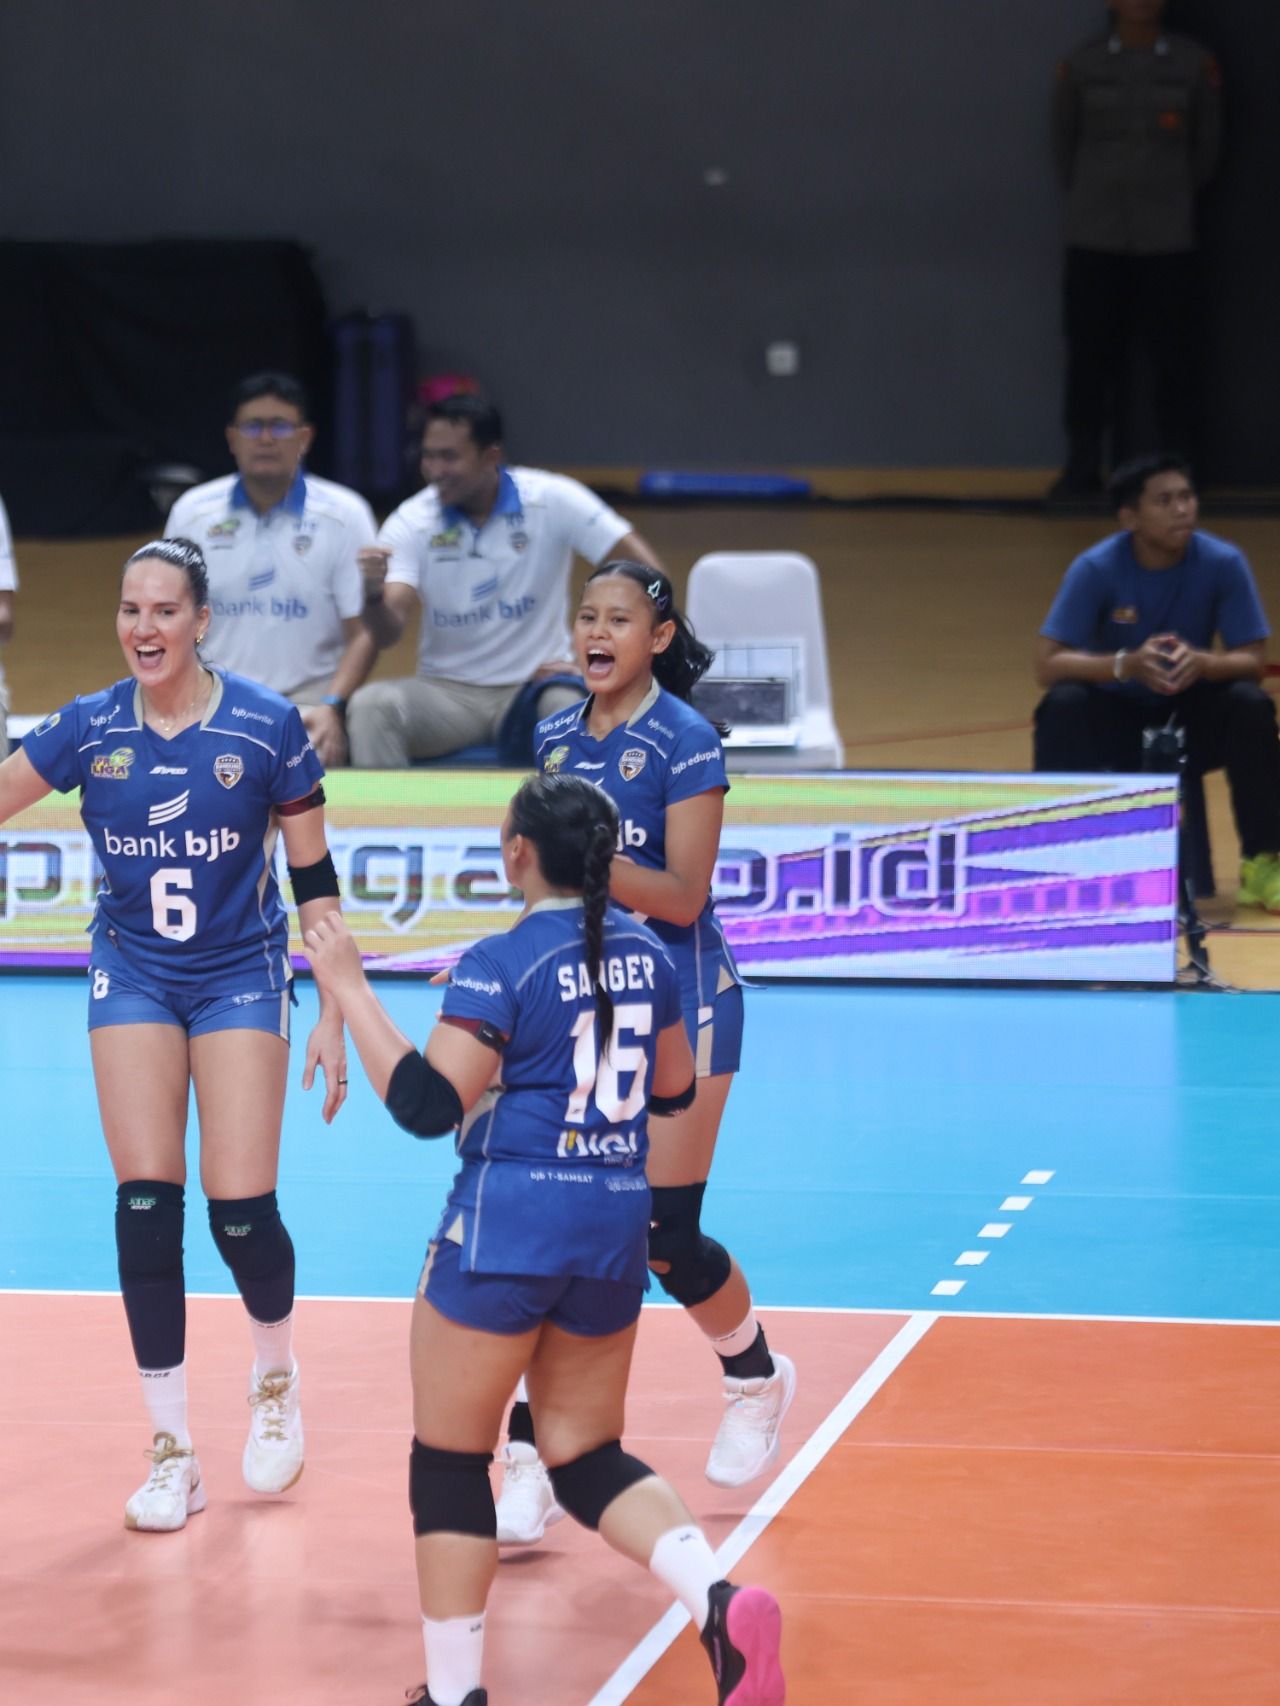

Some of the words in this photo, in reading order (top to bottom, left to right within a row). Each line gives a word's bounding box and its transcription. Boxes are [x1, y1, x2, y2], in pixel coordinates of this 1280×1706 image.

[270, 597, 307, 622] bjb
[671, 761, 687, 775] bjb
[104, 827, 177, 858] bank
[184, 828, 240, 863] bjb
[615, 819, 647, 852] jb
[150, 868, 198, 943] 6
[92, 969, 110, 1000] 6
[563, 1003, 653, 1123] 16
